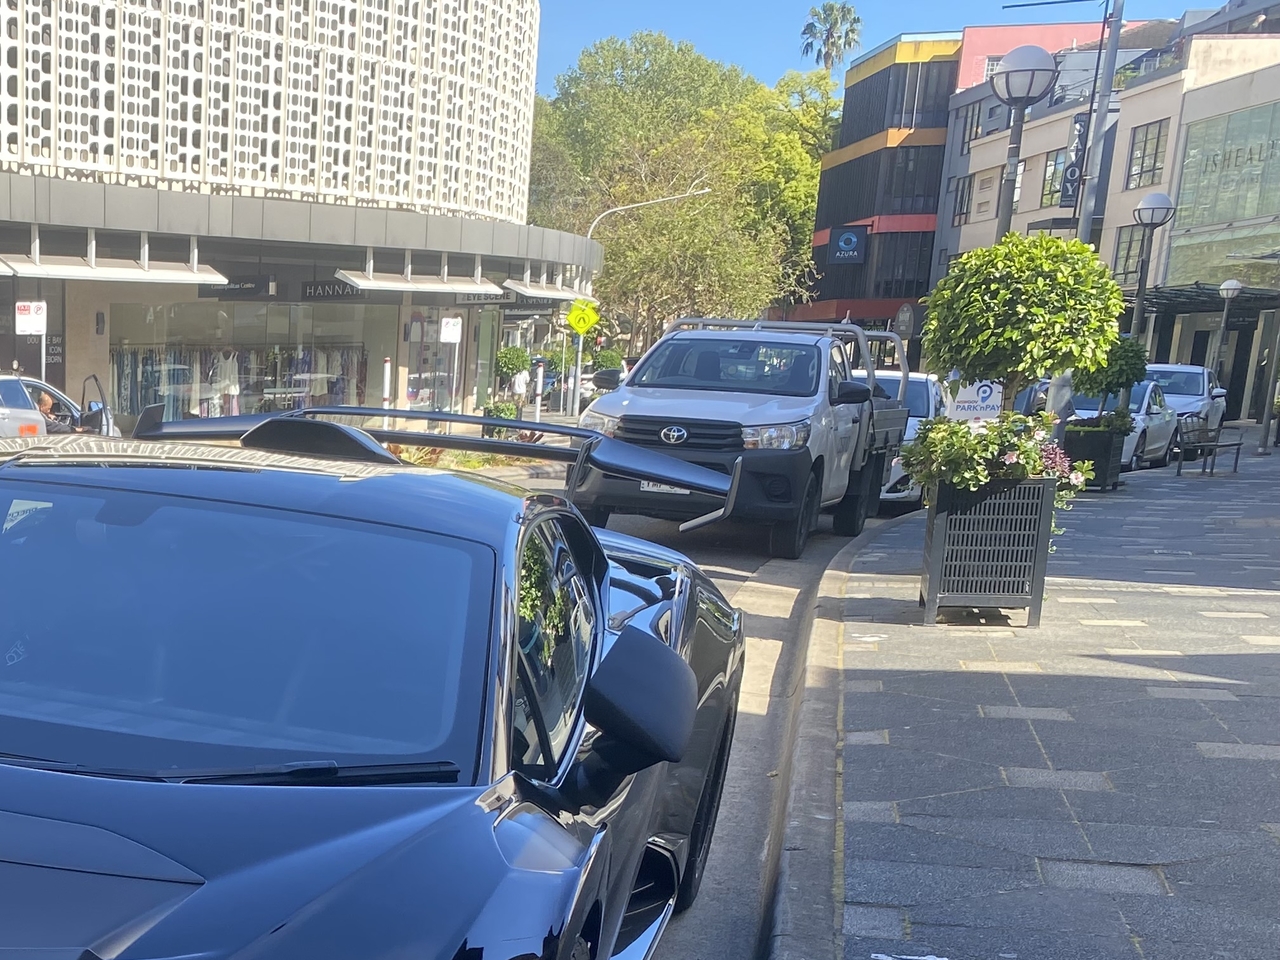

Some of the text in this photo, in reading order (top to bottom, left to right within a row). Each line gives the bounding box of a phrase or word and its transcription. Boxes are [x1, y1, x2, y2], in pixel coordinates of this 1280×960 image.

[1065, 121, 1085, 195] SAVOY
[835, 250, 858, 258] AZURA
[306, 285, 362, 297] HANNAH
[466, 293, 482, 301] EYE
